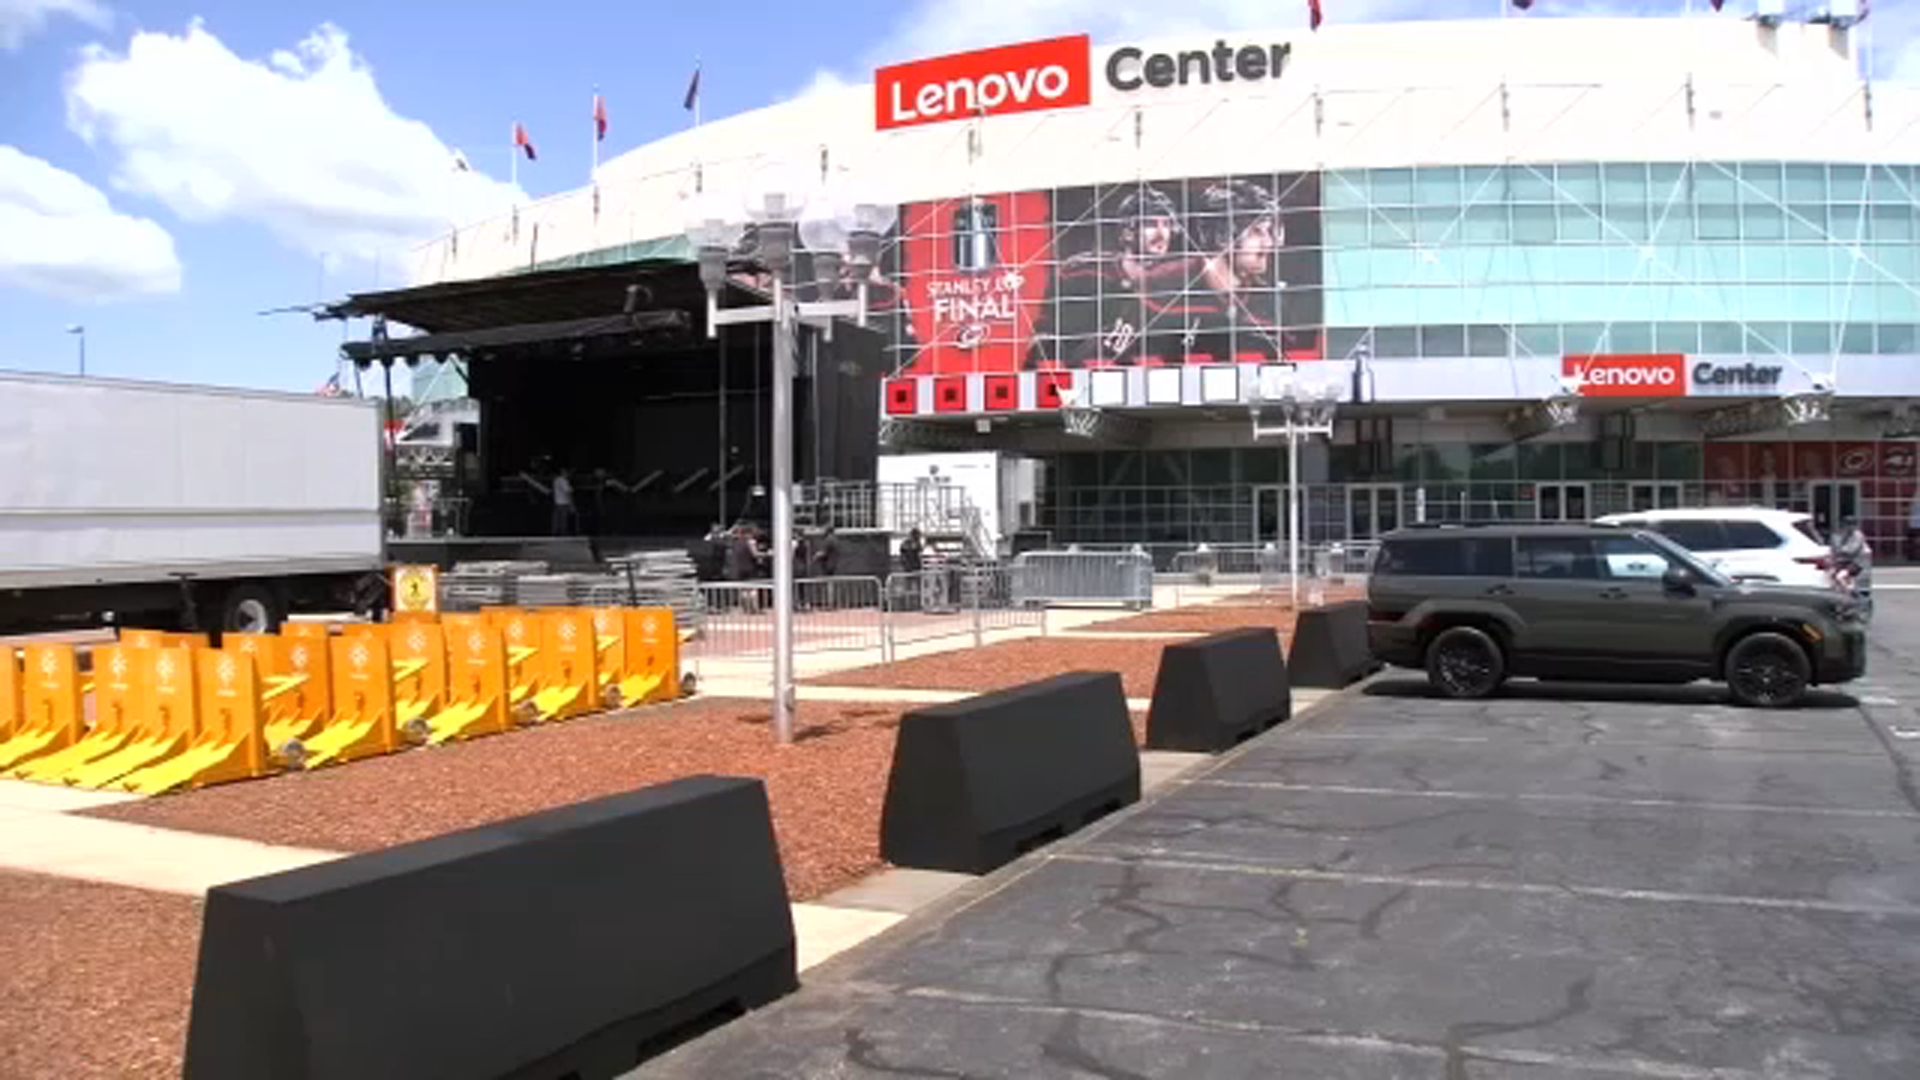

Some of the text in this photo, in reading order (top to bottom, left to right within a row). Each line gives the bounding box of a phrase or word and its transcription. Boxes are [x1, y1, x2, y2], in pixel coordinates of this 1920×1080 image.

[891, 40, 1292, 121] Lenovo Center
[935, 294, 1015, 323] FINAL
[1573, 361, 1782, 385] Lenovo Center
